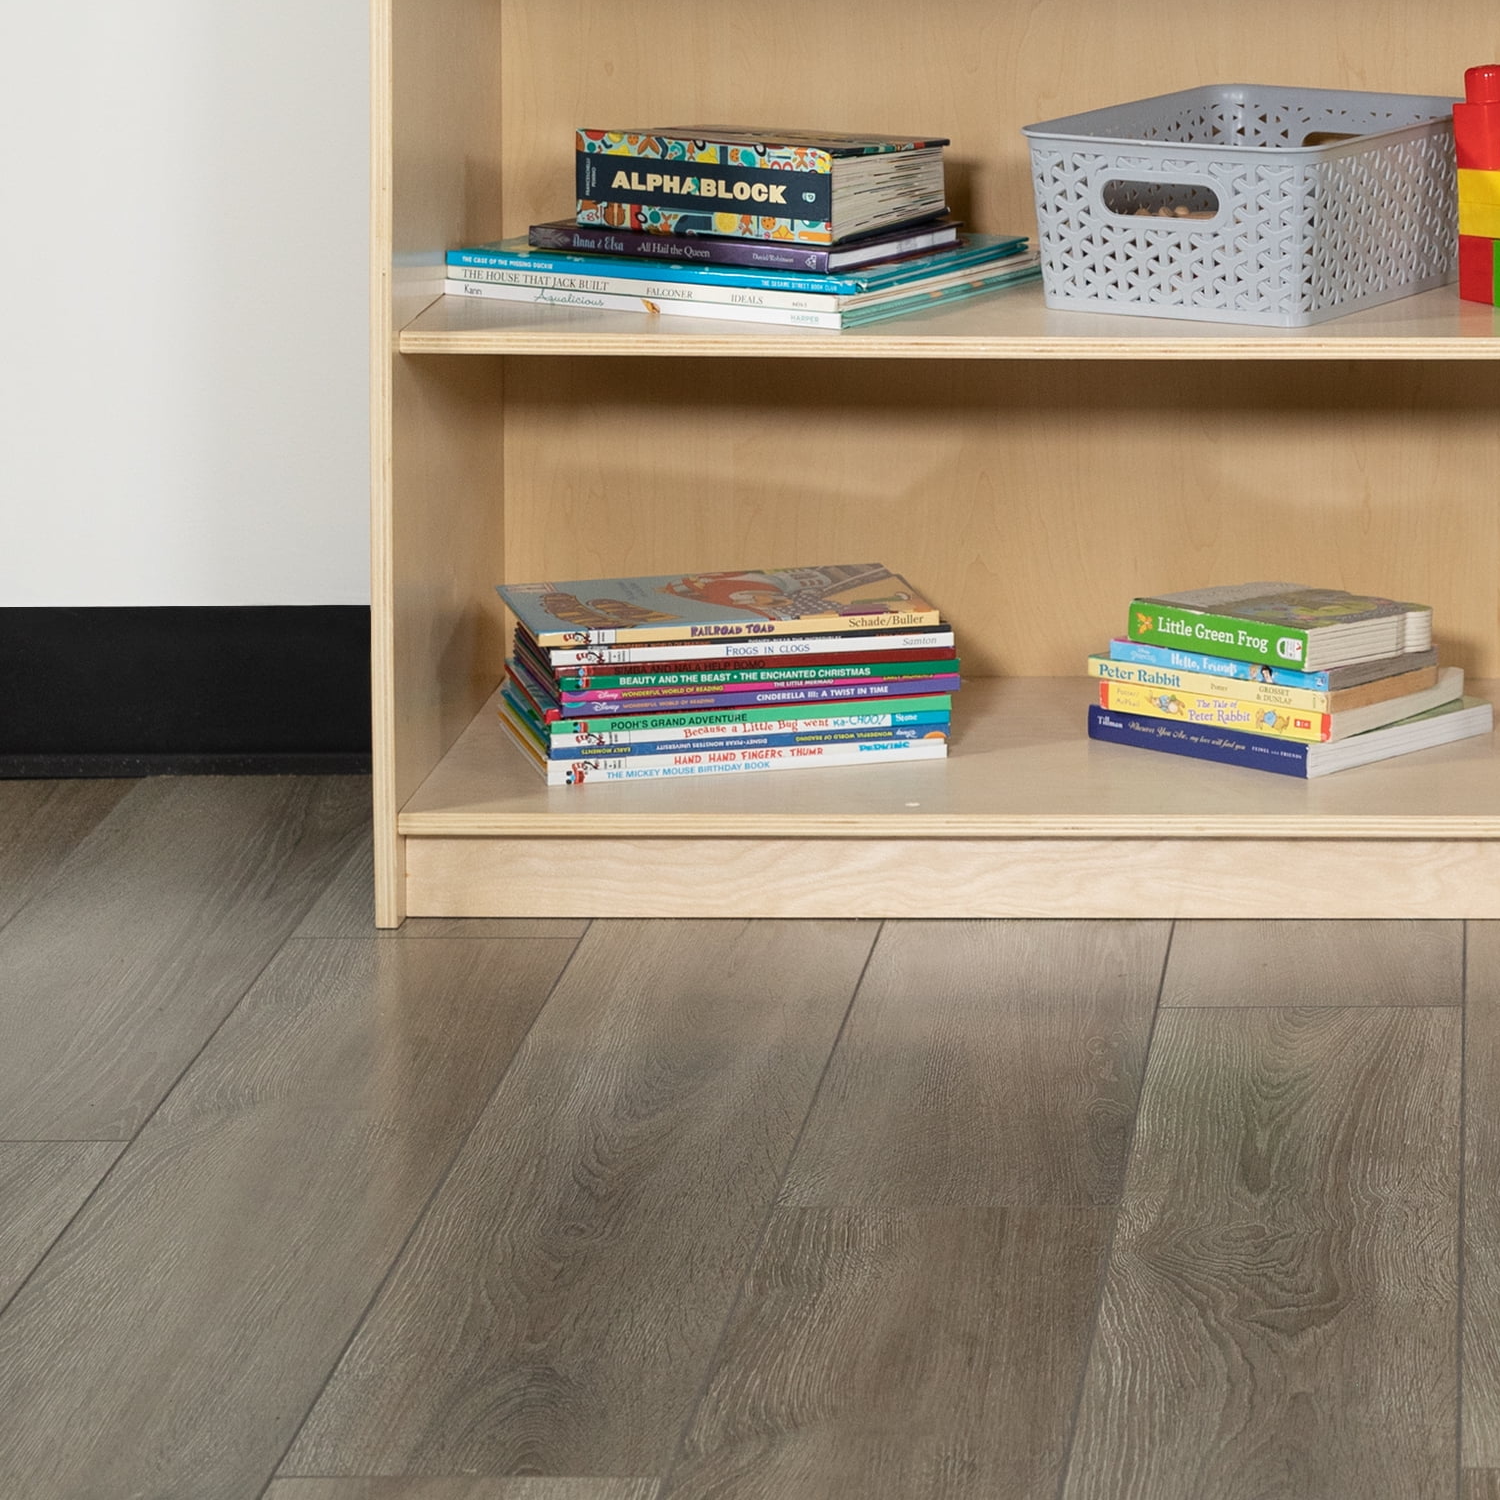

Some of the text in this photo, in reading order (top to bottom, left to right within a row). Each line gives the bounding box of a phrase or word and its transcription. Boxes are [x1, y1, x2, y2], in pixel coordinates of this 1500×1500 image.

[611, 170, 787, 204] ALPHABLOCK
[572, 233, 624, 251] Anna Elsa
[637, 242, 711, 259] All Hail the Queen
[462, 255, 532, 268] THE CASE MISSING
[461, 268, 610, 292] THE HOUSE THAT JACK BUILT
[464, 283, 483, 296] Kann
[646, 287, 693, 299] FALCONER
[730, 294, 764, 305] IDEALS
[789, 314, 820, 323] HARPER
[848, 613, 925, 629] Schade/Buller
[690, 623, 775, 638] RAILROAD TOAD
[1157, 616, 1269, 653] Little Green Frog
[902, 636, 937, 647] Samton
[725, 643, 810, 656] FROGS IN CLOGS
[1171, 651, 1200, 671] Hello,
[619, 667, 871, 686] BEAUTY AND THE BEAST THE ENCHANTED CHRISTMAS
[1098, 663, 1181, 688] Peter Rabbit
[596, 685, 725, 700] Disney WONDERFUL WORLD OF READING
[756, 685, 889, 702] CINDERELLA III: A TWIST IN TIME
[1258, 686, 1290, 697] GROSSET
[592, 697, 715, 713] Disney WONDERFUL WORLD READING
[1196, 699, 1239, 709] The Tale of
[610, 713, 748, 731] POOH'S GRAND ADVENTURE
[895, 712, 918, 723] Stone
[1097, 715, 1123, 729] Tillman
[1188, 709, 1251, 724] Peter Rabbit
[682, 718, 830, 739] Because Little Bug went
[833, 732, 856, 740] WORLD
[855, 731, 893, 739] WONDERFUL
[895, 728, 918, 739] Disney
[794, 734, 823, 743] READING
[581, 746, 631, 755] EARLY MOMENTS
[673, 749, 784, 765] HAND HAND FINGERS
[606, 760, 771, 779] THE MICKEY MOUSE BIRTHDAY BOOK
